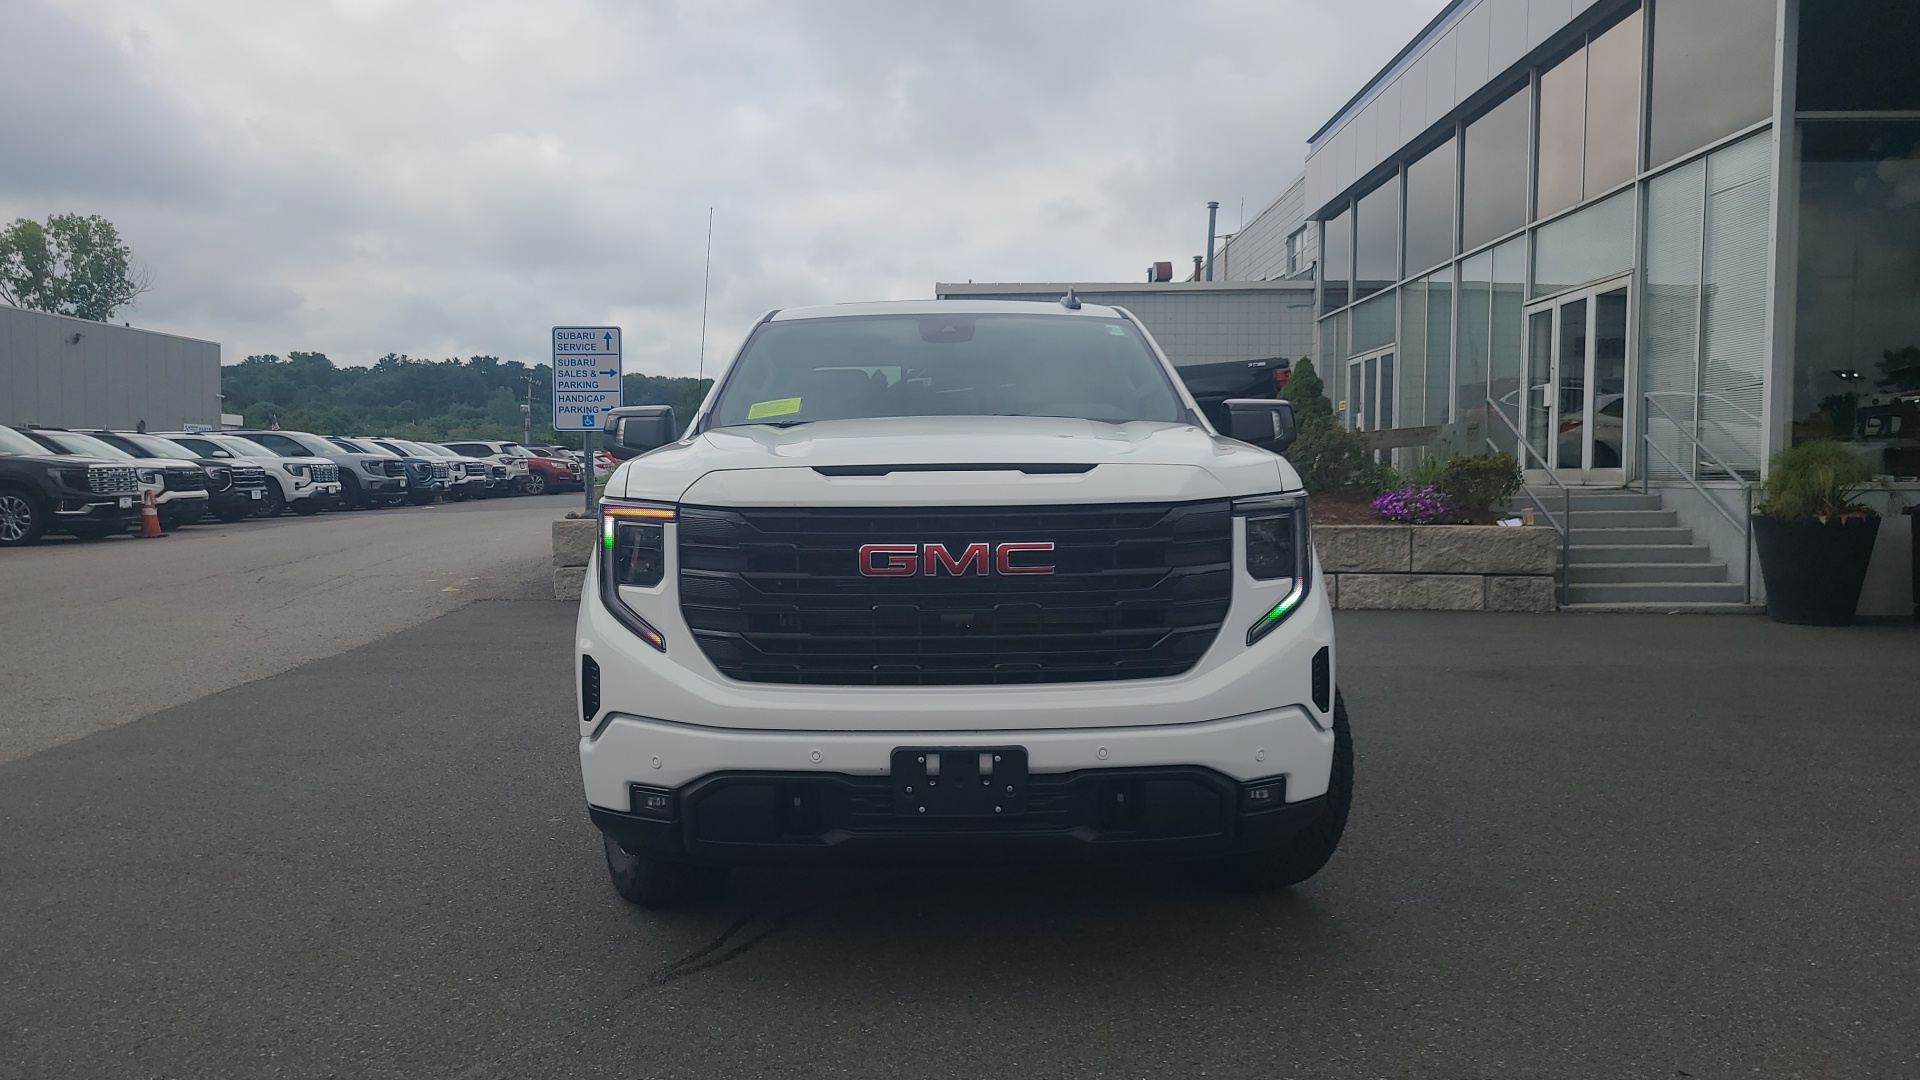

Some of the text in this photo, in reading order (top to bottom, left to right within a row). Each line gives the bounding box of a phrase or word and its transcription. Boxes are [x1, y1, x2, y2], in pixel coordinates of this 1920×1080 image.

[557, 332, 596, 340] SUBARU
[557, 343, 597, 351] SERVICE
[557, 359, 596, 367] SUBARU
[558, 370, 597, 378] SALES &
[558, 381, 599, 389] PARKING
[558, 395, 606, 403] HANDICAP
[558, 406, 599, 414] PARKING
[858, 541, 1056, 577] GMC
